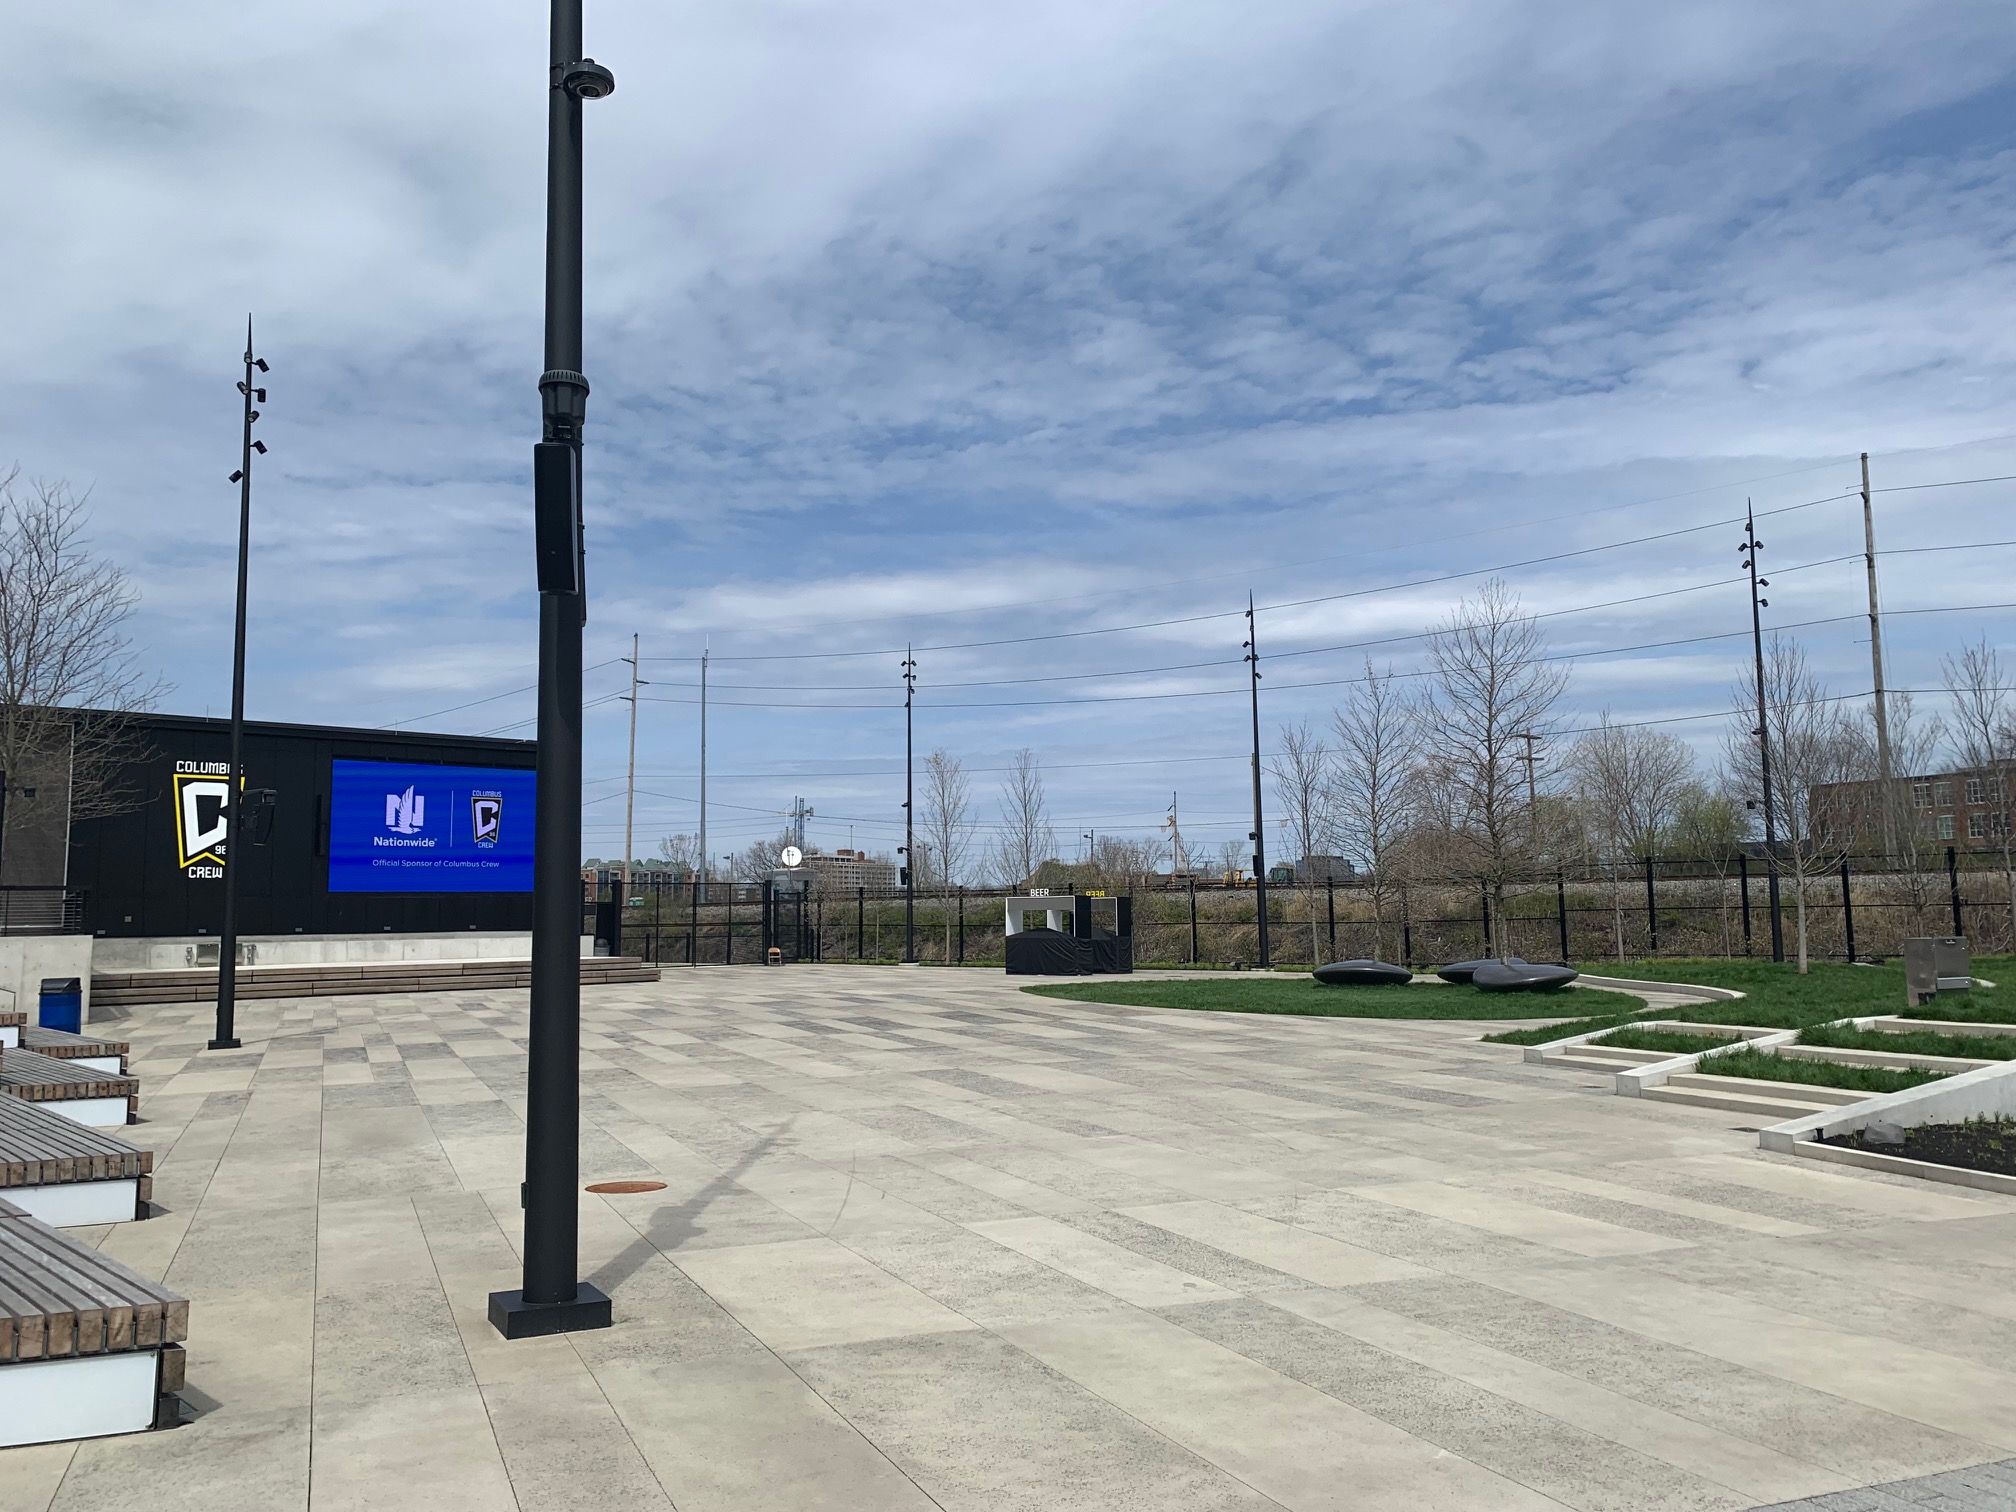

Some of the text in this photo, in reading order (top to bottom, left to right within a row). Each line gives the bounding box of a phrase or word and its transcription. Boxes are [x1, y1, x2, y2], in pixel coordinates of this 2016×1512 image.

[176, 760, 244, 775] COLUMB
[472, 790, 502, 798] COLUMBUS
[373, 836, 436, 848] Nationwide
[372, 859, 400, 867] Official
[401, 860, 433, 869] Sponsor
[433, 860, 443, 868] of
[188, 866, 223, 878] CREW
[1030, 888, 1050, 897] BEER
